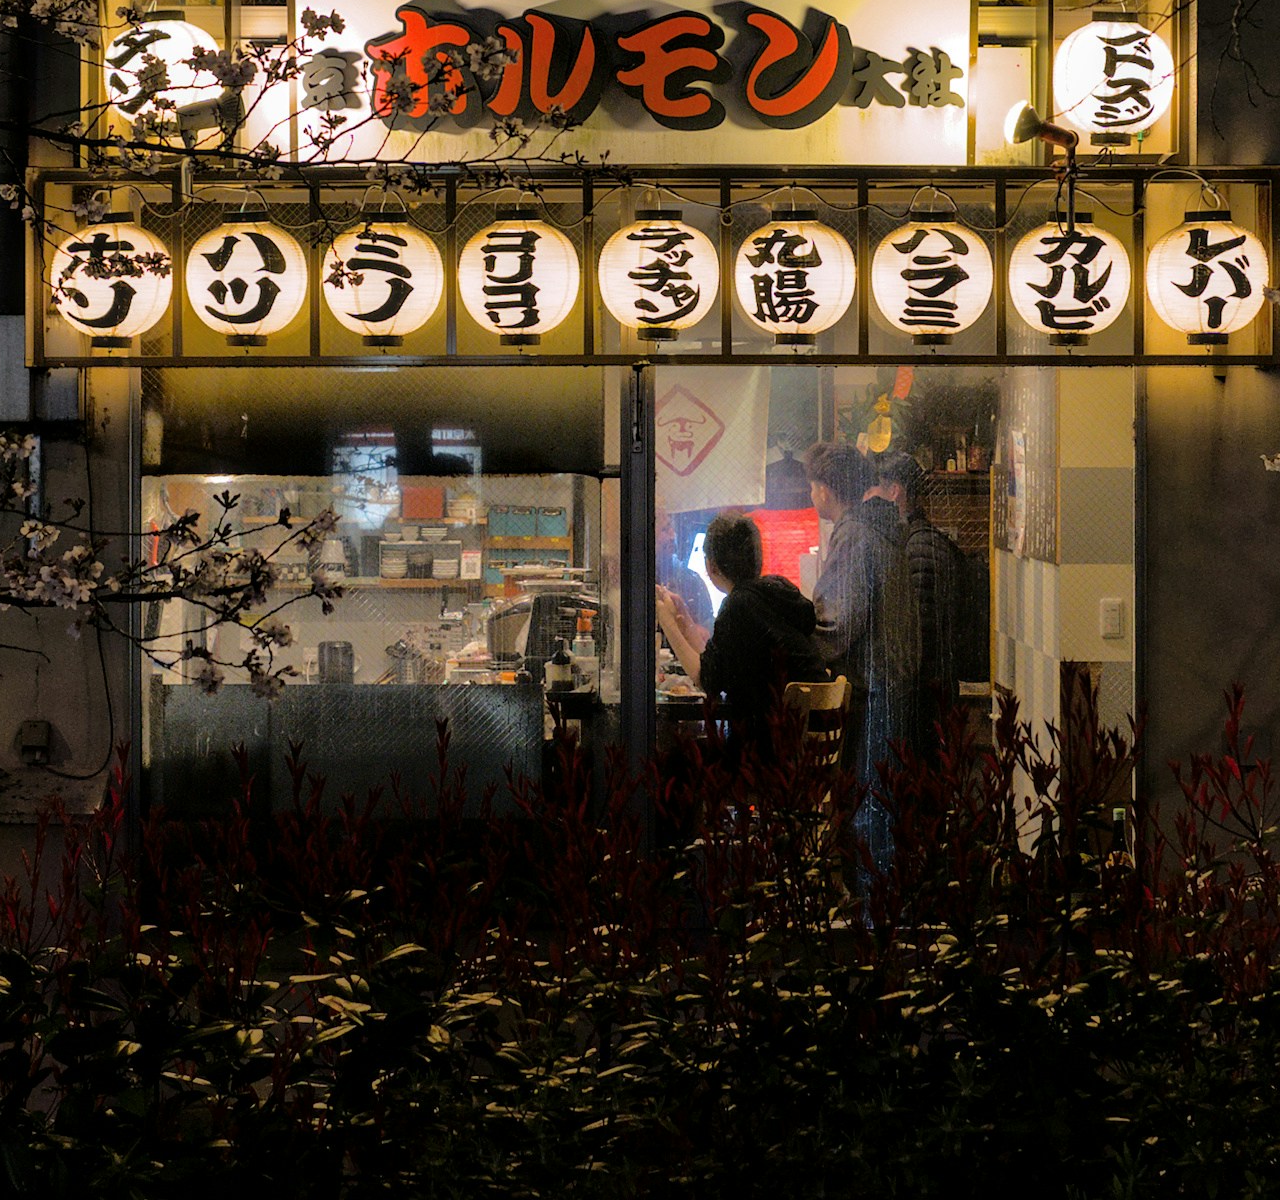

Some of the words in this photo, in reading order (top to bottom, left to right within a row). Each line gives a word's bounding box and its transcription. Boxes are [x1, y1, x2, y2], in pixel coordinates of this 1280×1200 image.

[1091, 30, 1155, 128] ノドスジ
[61, 233, 138, 328] ホソ
[200, 231, 287, 324] ハツ
[346, 231, 412, 322] ミノ
[480, 231, 542, 328] コリコリ
[626, 227, 700, 324] テッチャン
[744, 228, 821, 323] 丸腸
[891, 228, 970, 328] ハラミ
[1026, 230, 1112, 328] カルビ
[1171, 228, 1251, 327] レバー
